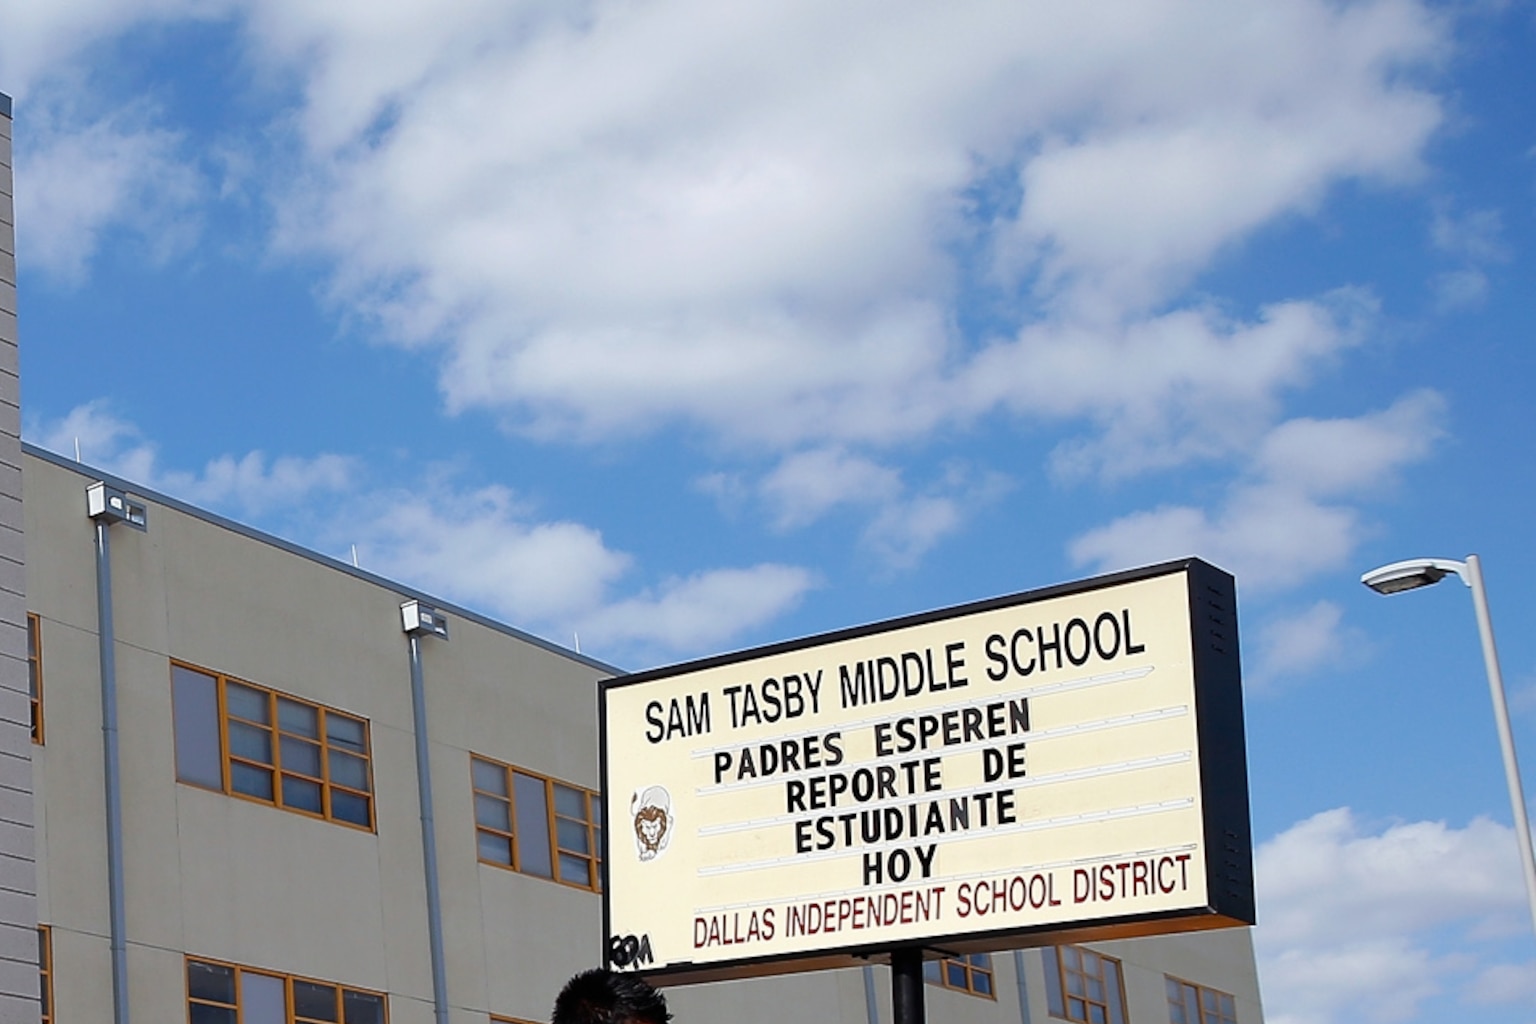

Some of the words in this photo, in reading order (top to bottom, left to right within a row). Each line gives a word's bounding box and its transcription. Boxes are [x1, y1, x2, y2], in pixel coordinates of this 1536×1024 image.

[645, 691, 711, 744] SAM
[722, 669, 823, 729] TASBY
[838, 641, 969, 709] MIDDLE
[985, 608, 1146, 682] SCHOOL
[714, 731, 844, 785] PADRES
[873, 697, 1031, 758] ESPEREN
[786, 756, 943, 814] REPORTE
[982, 742, 1026, 783] DE
[795, 788, 1017, 854] ESTUDIANTE
[693, 907, 775, 949] DALLAS
[785, 886, 946, 939] INDEPENDENT
[956, 872, 1062, 918] SCHOOL
[1073, 853, 1192, 904] DISTRICT
[862, 843, 938, 886] HOY
